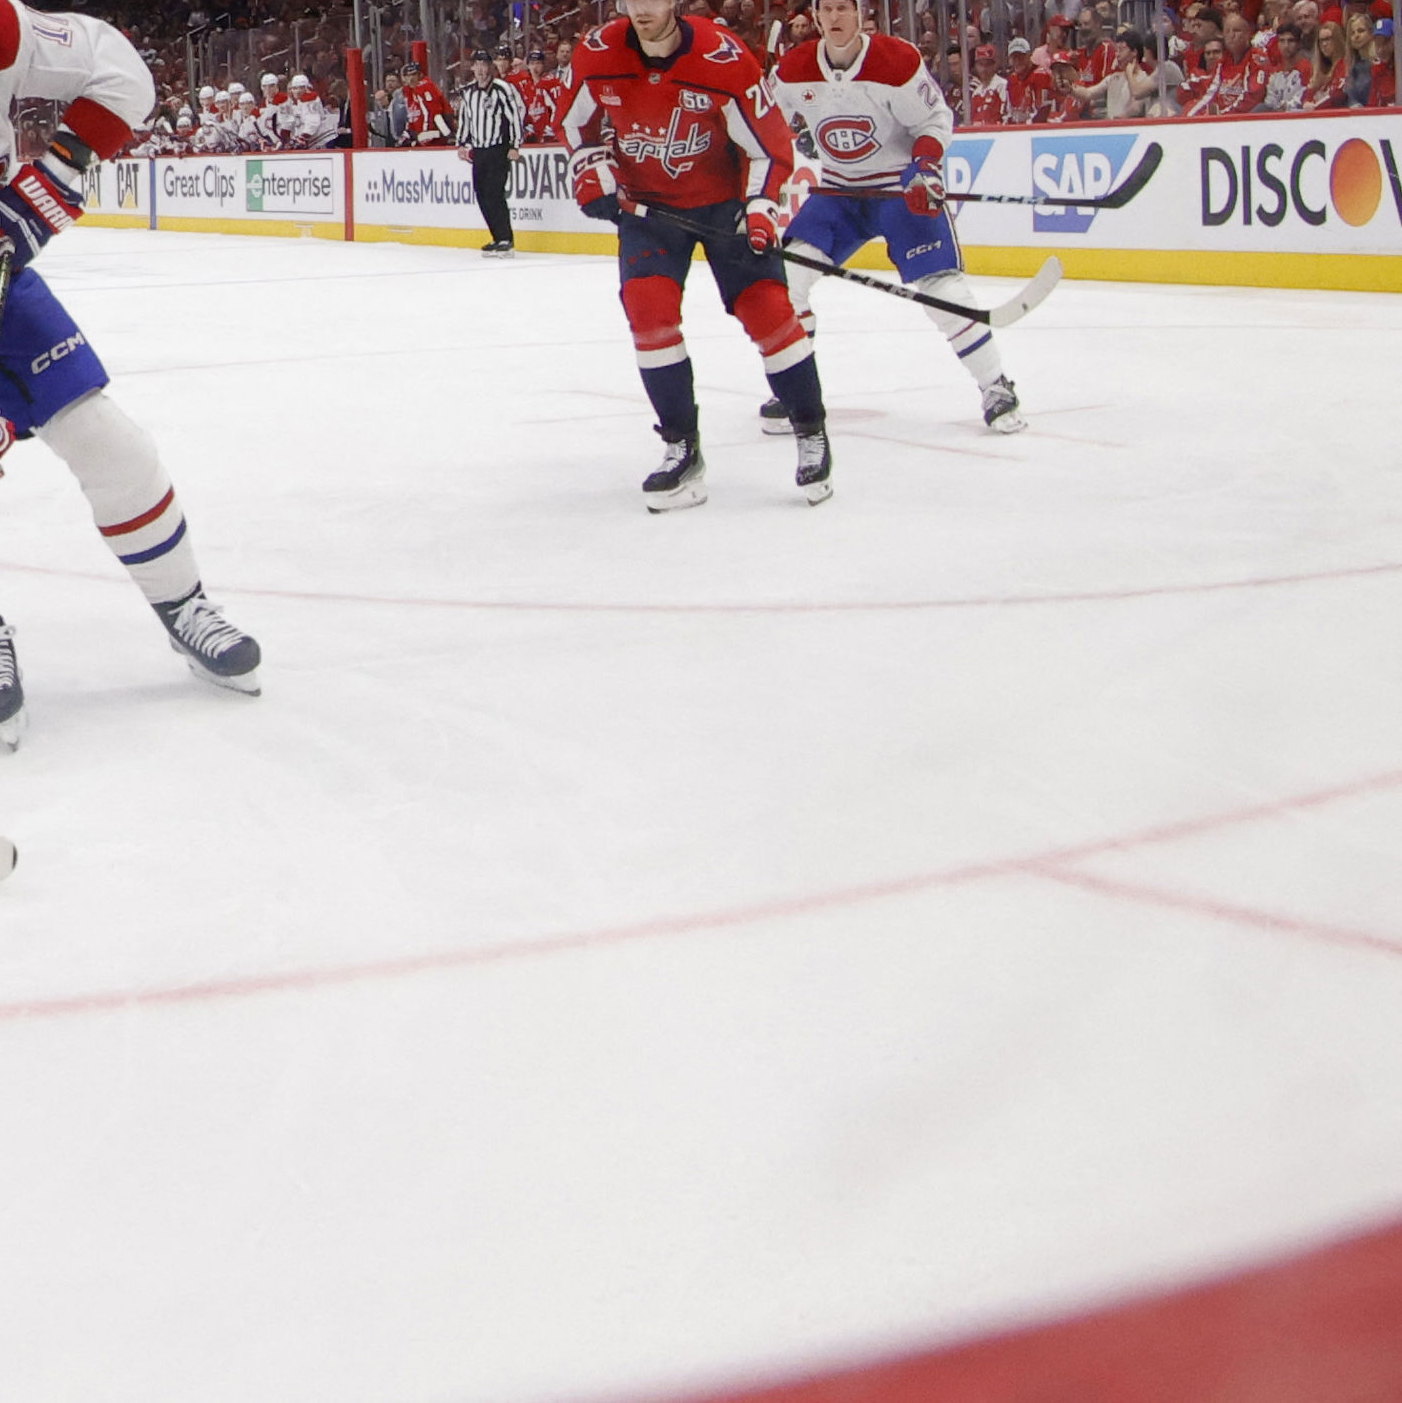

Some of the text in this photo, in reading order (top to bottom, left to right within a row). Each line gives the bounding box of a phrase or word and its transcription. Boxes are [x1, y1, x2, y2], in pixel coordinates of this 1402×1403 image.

[117, 163, 139, 196] CAT
[163, 164, 235, 200] Great Clips
[17, 175, 77, 229] WARR
[906, 240, 942, 260] CCM
[31, 332, 86, 375] CCM
